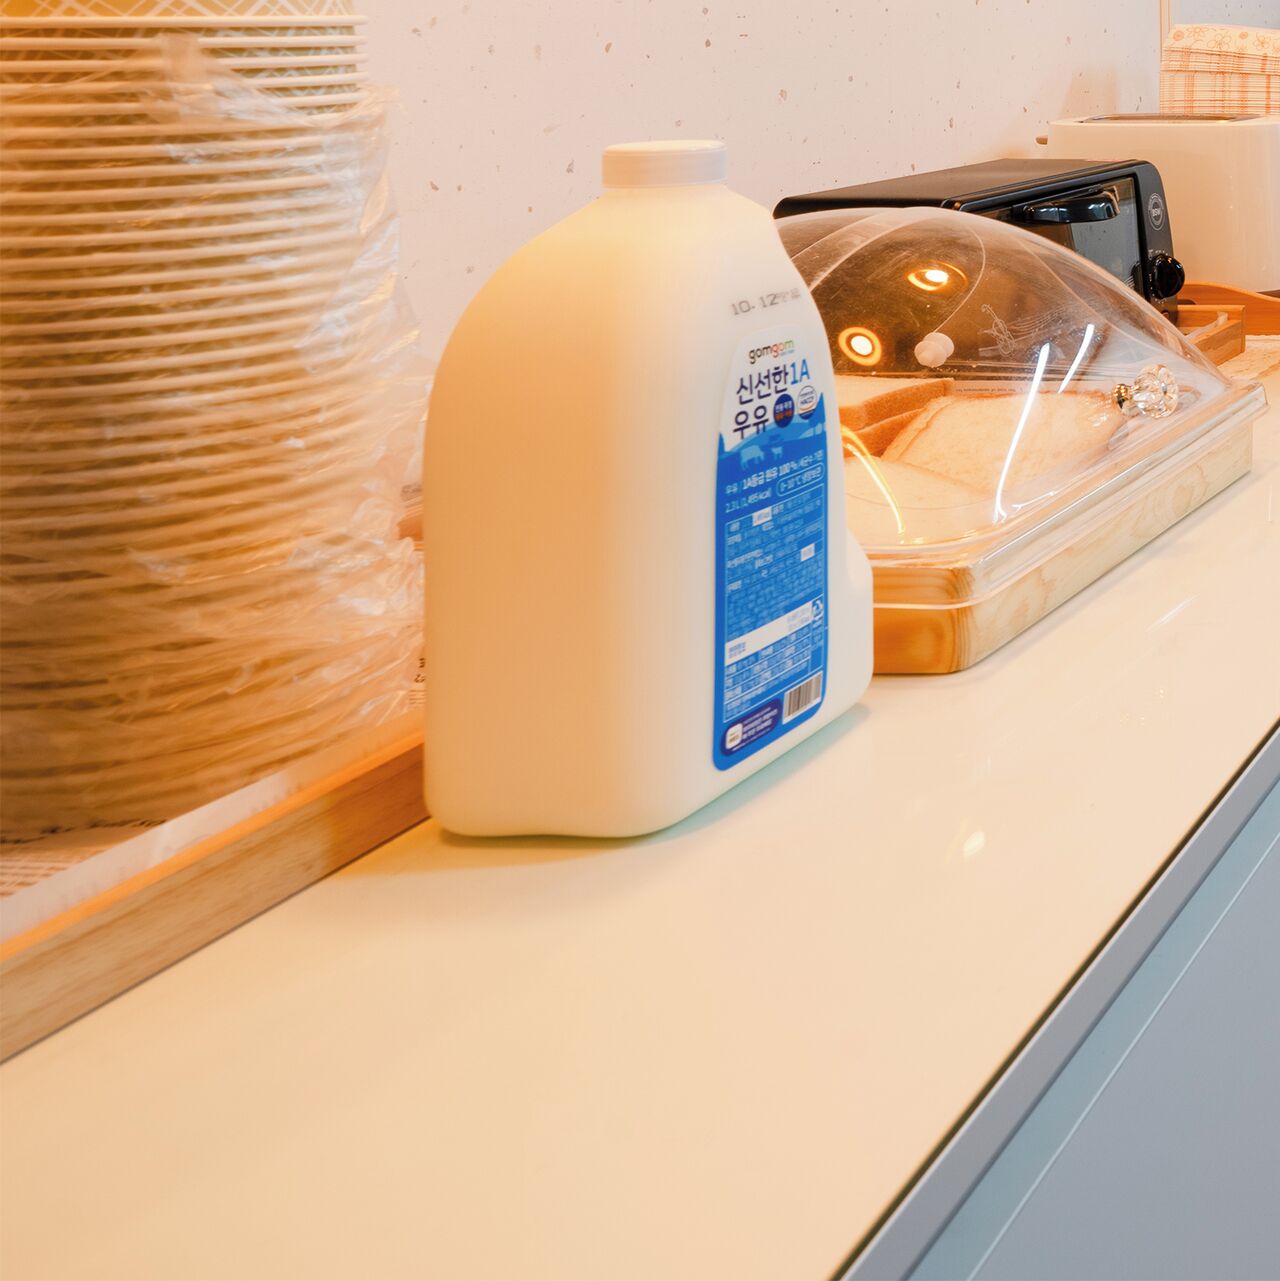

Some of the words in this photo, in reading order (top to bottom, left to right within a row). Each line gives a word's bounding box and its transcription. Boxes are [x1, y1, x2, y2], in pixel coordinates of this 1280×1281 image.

[749, 339, 795, 365] gomgom
[736, 364, 789, 405] 신선한
[790, 358, 810, 385] 1A
[733, 405, 769, 440] 우유
